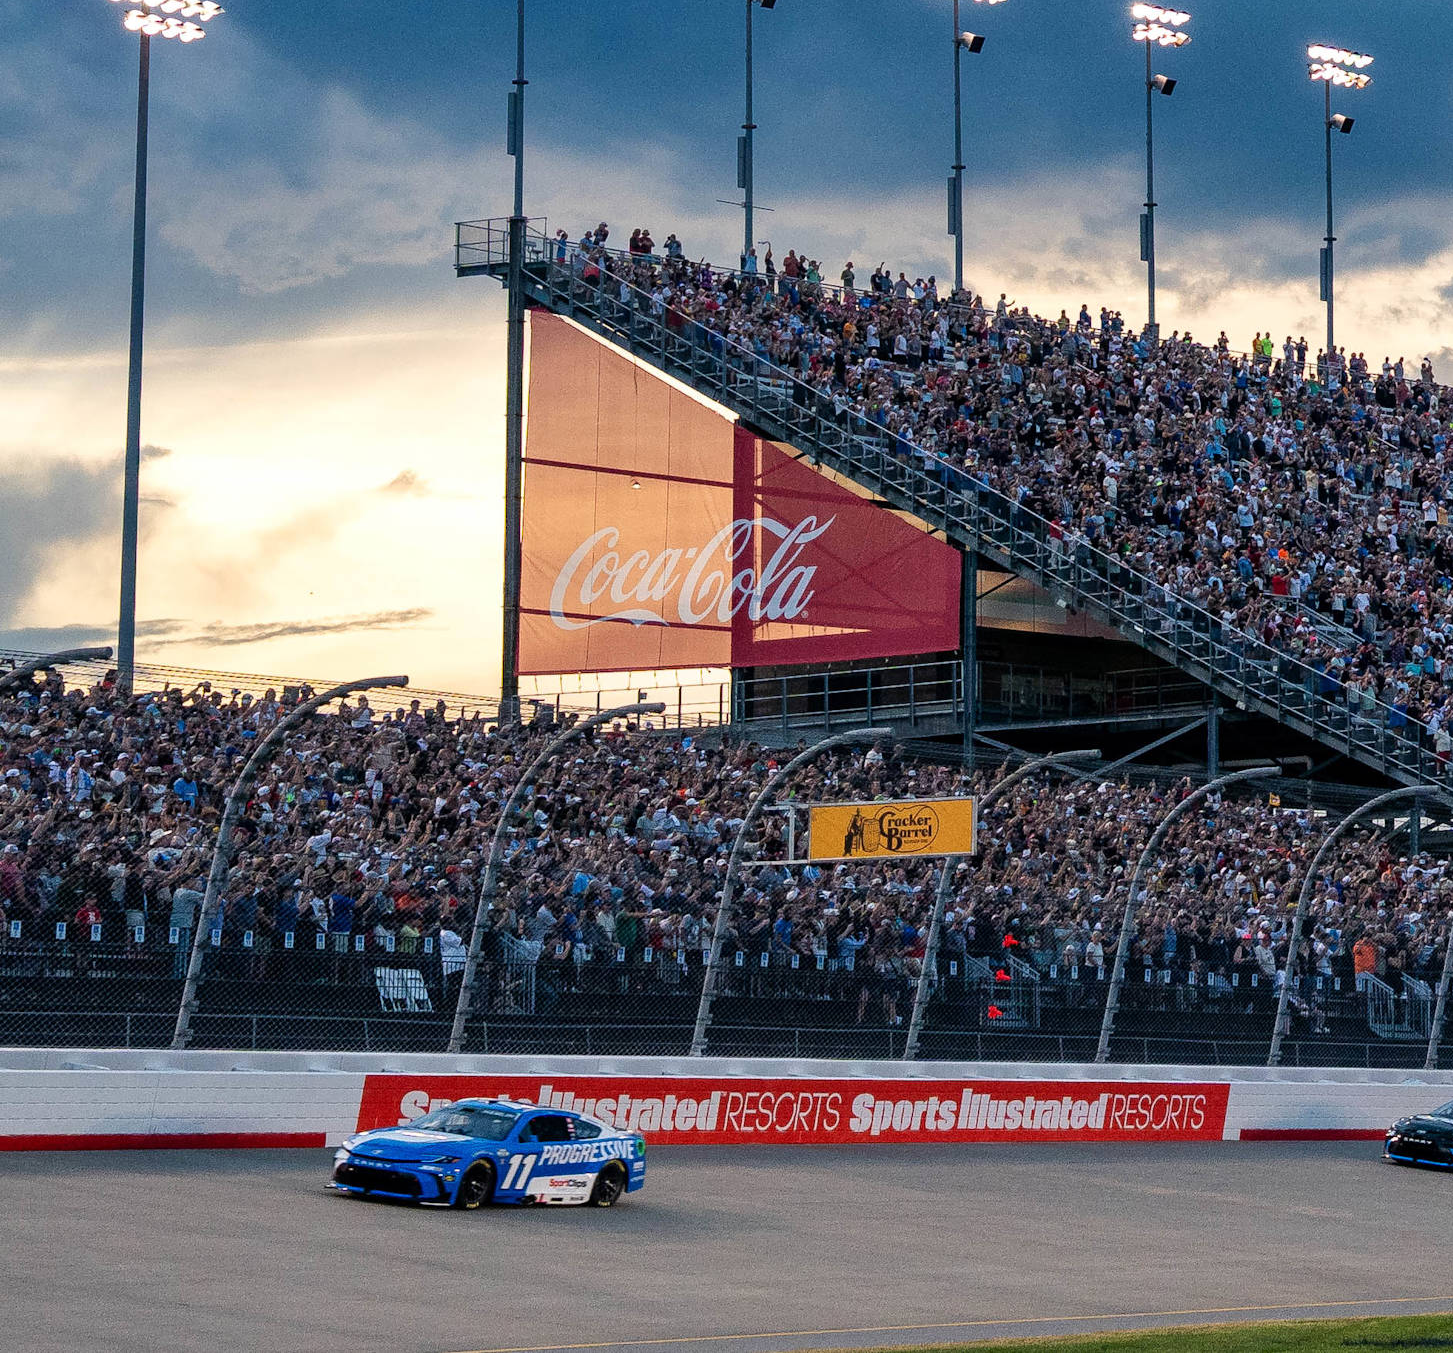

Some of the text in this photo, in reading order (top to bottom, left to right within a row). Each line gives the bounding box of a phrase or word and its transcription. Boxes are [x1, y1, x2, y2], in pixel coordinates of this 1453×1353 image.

[550, 514, 836, 630] Coca-Cola
[879, 811, 932, 838] Cracker
[886, 825, 932, 851] Barrel
[723, 1092, 842, 1131] RESORTS
[849, 1093, 957, 1136] Sports
[957, 1088, 1108, 1130] Illustrated
[1110, 1094, 1206, 1130] RESORTS
[538, 1140, 634, 1165] PROGRESSIVE
[501, 1154, 537, 1190] 11
